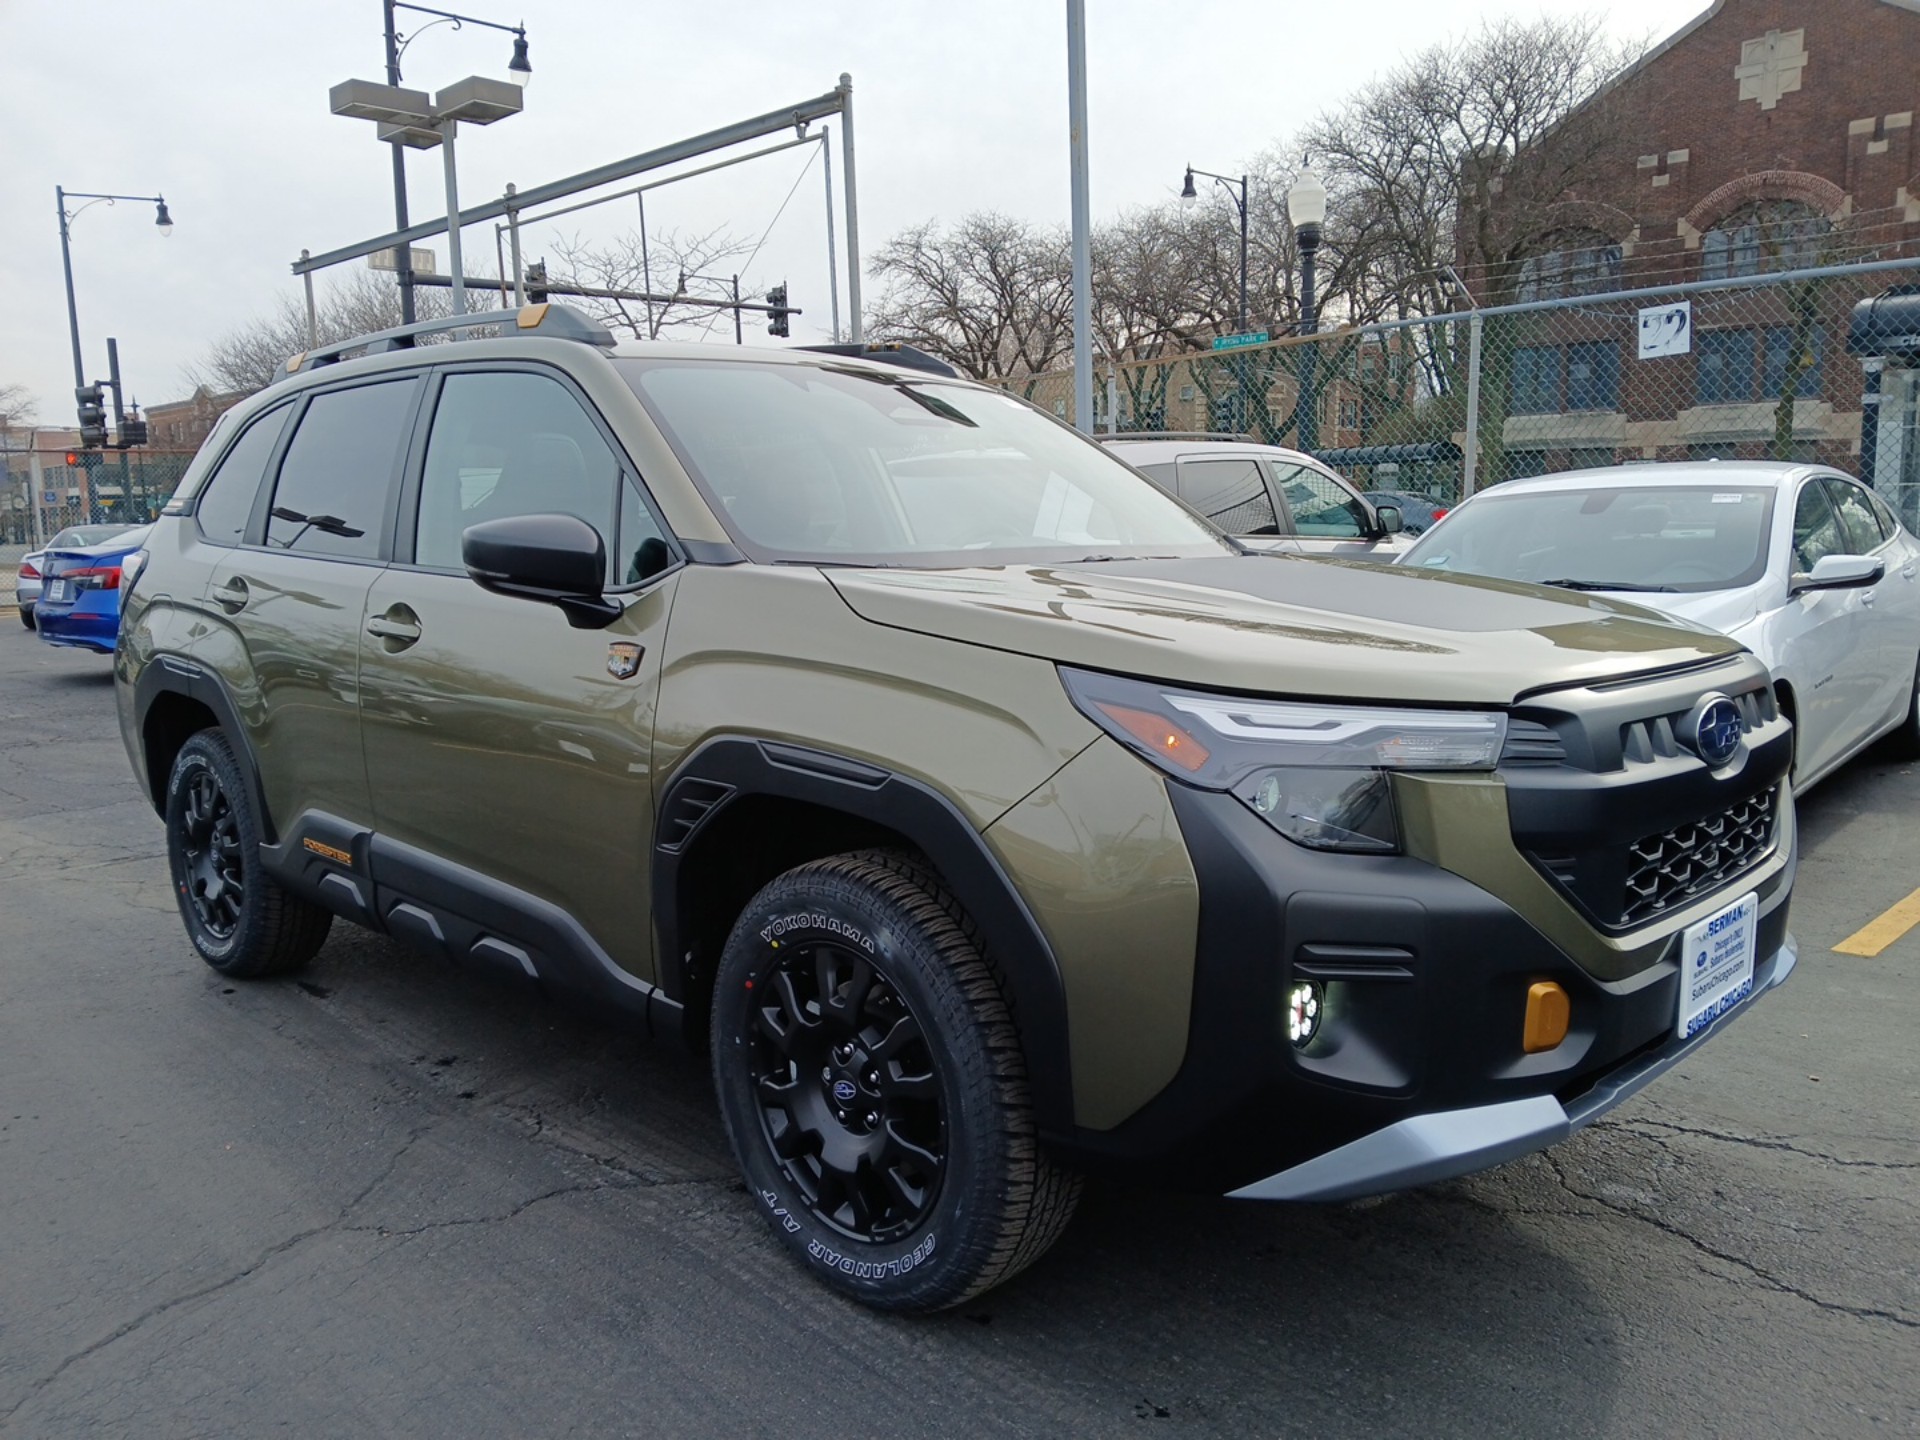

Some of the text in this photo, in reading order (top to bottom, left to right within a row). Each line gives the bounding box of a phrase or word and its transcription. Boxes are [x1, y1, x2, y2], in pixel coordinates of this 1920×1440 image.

[760, 914, 875, 954] YOKOHAMA
[1708, 904, 1744, 936] BERMAN
[1691, 960, 1745, 1002] SubaruChicago.com
[1720, 978, 1752, 1012] CHICAGO
[762, 1189, 801, 1233] A/T
[808, 1233, 936, 1279] GEOLANDAR
